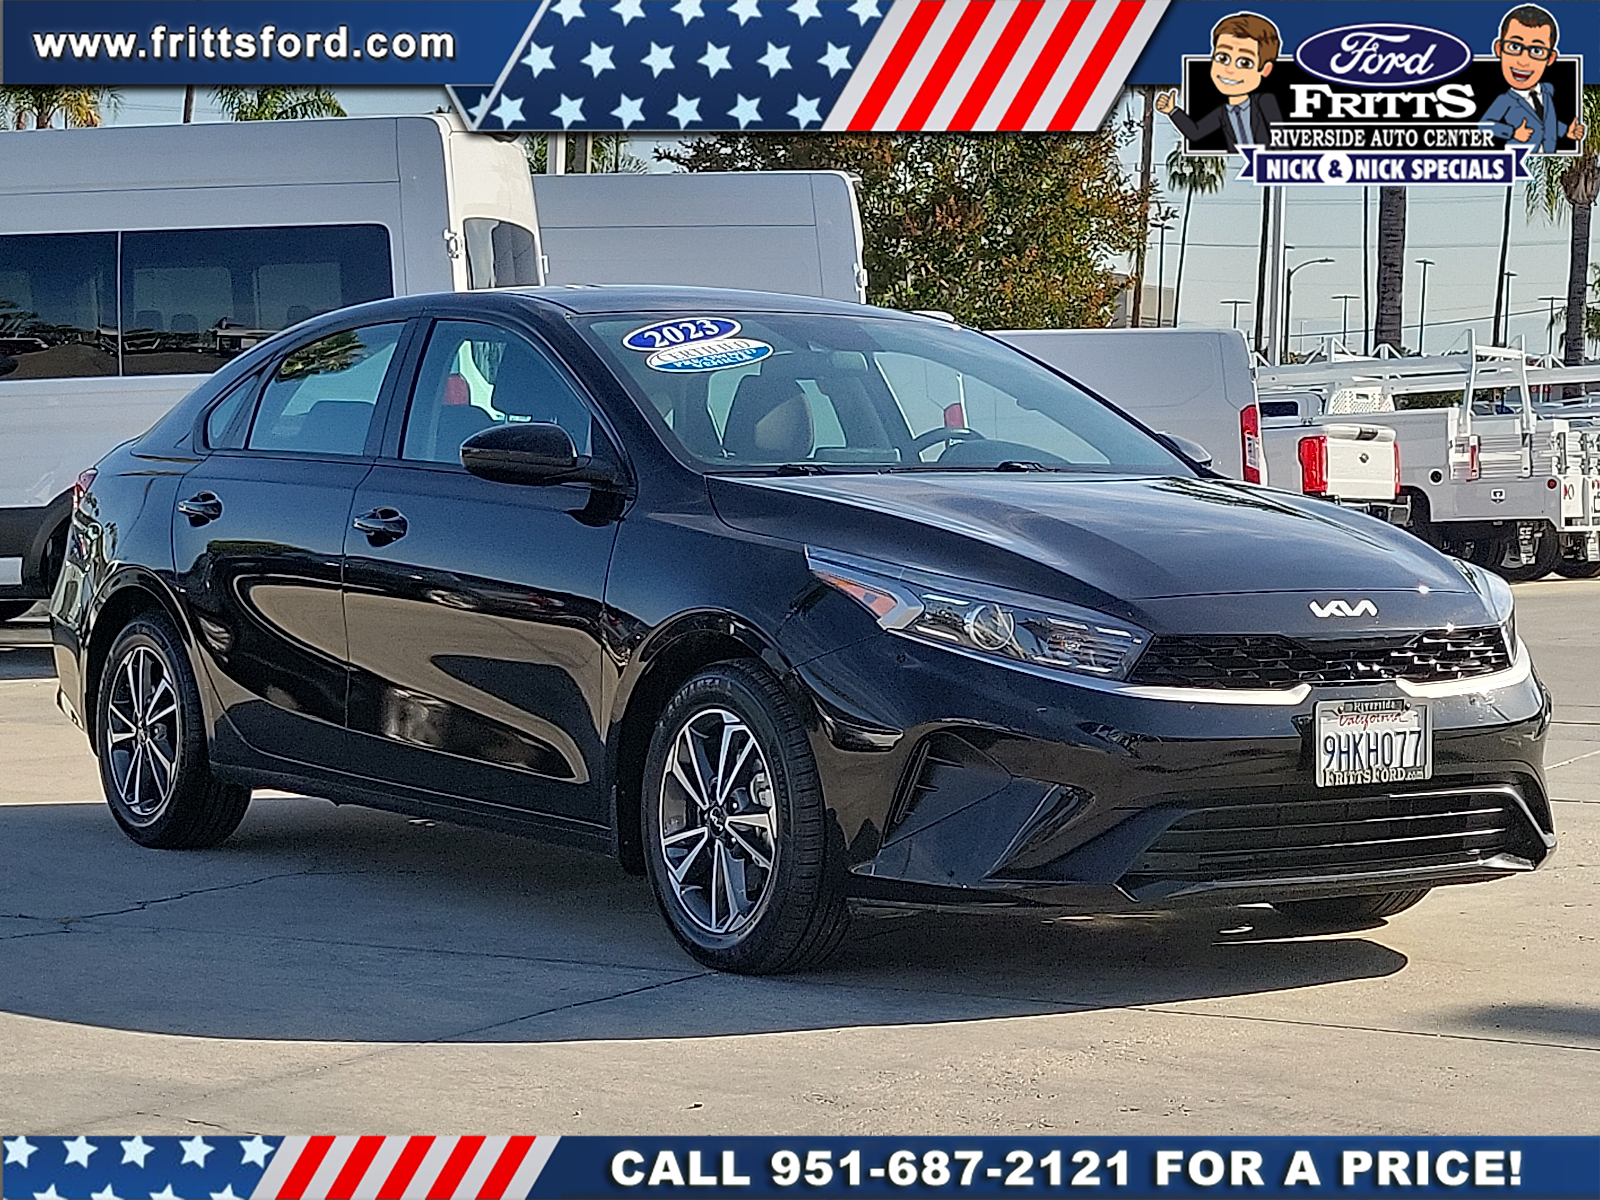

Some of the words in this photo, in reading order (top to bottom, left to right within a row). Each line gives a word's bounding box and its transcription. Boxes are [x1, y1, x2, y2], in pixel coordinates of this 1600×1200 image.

[643, 318, 720, 348] 2023
[1308, 599, 1378, 618] KIA
[1339, 712, 1406, 731] California
[1323, 730, 1421, 769] 9HKH077
